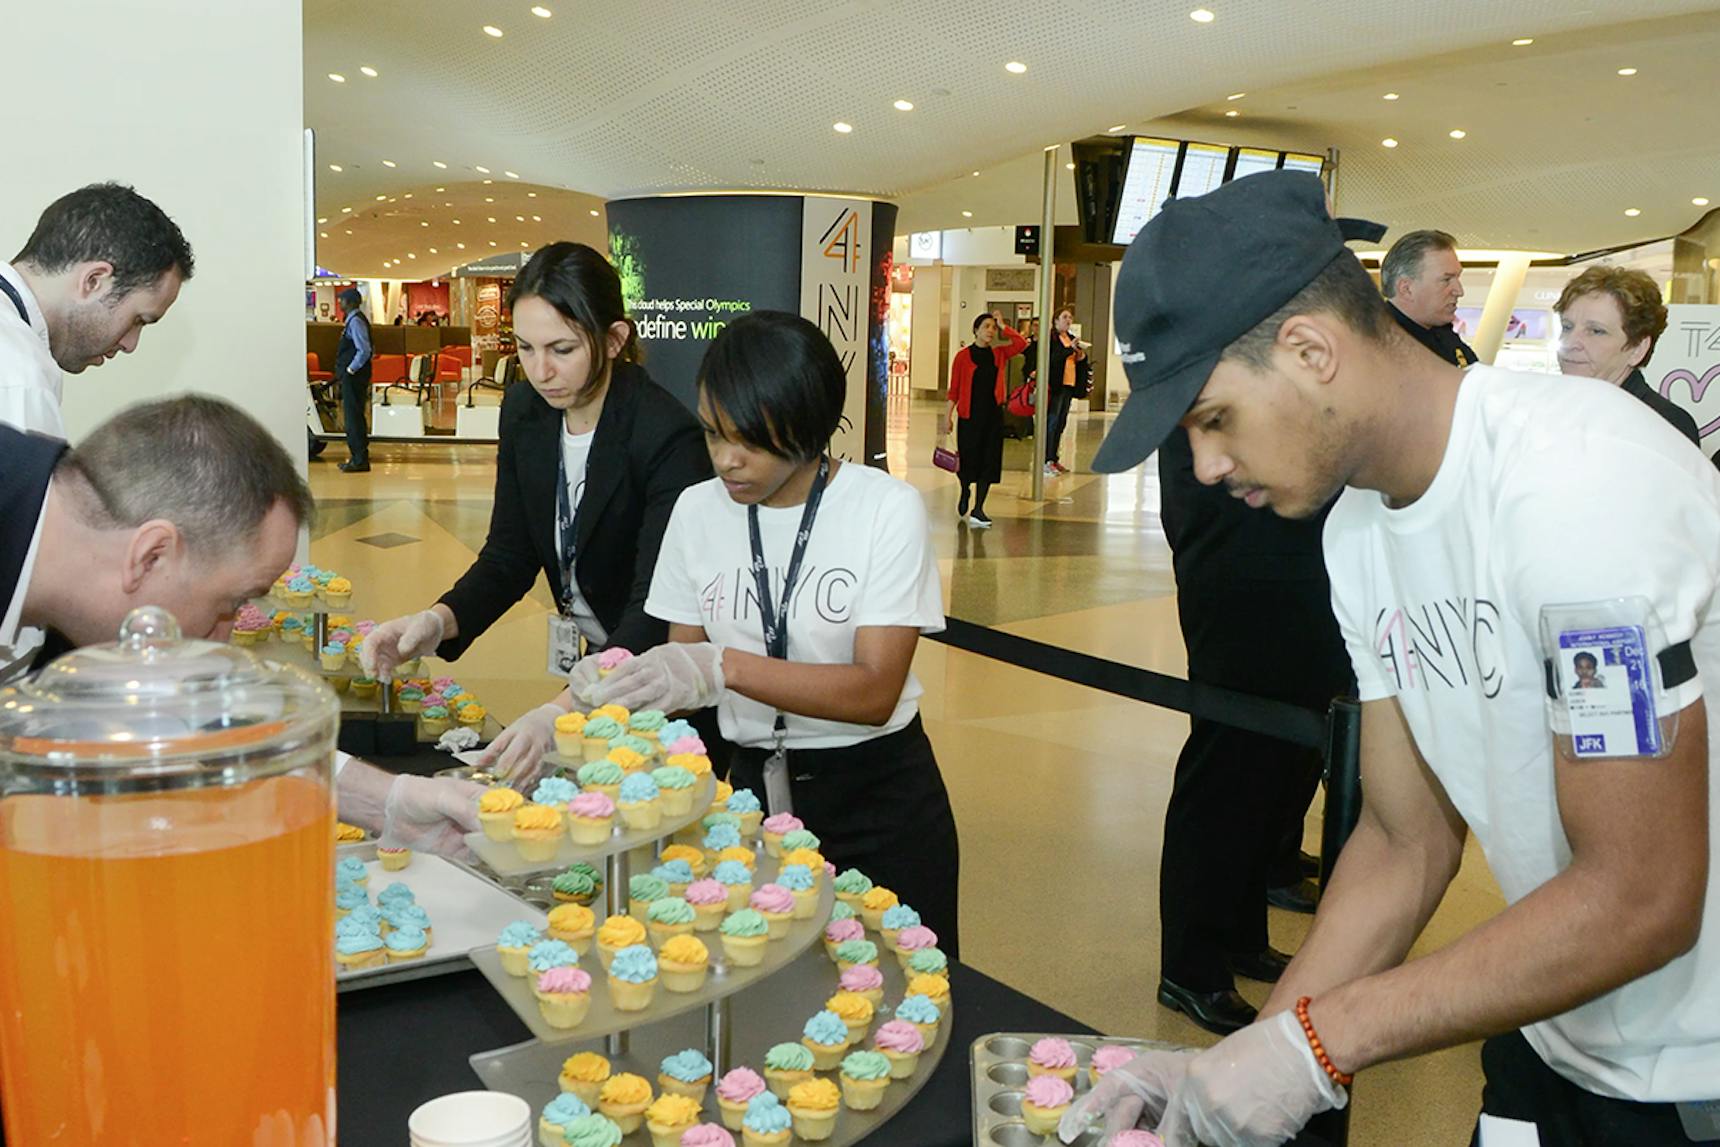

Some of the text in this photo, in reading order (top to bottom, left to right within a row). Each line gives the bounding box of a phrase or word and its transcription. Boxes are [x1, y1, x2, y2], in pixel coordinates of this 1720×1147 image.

[638, 299, 655, 310] cloud
[655, 299, 674, 312] helps
[675, 299, 704, 312] Special
[705, 298, 751, 313] Olympics
[1579, 737, 1603, 750] JFK
